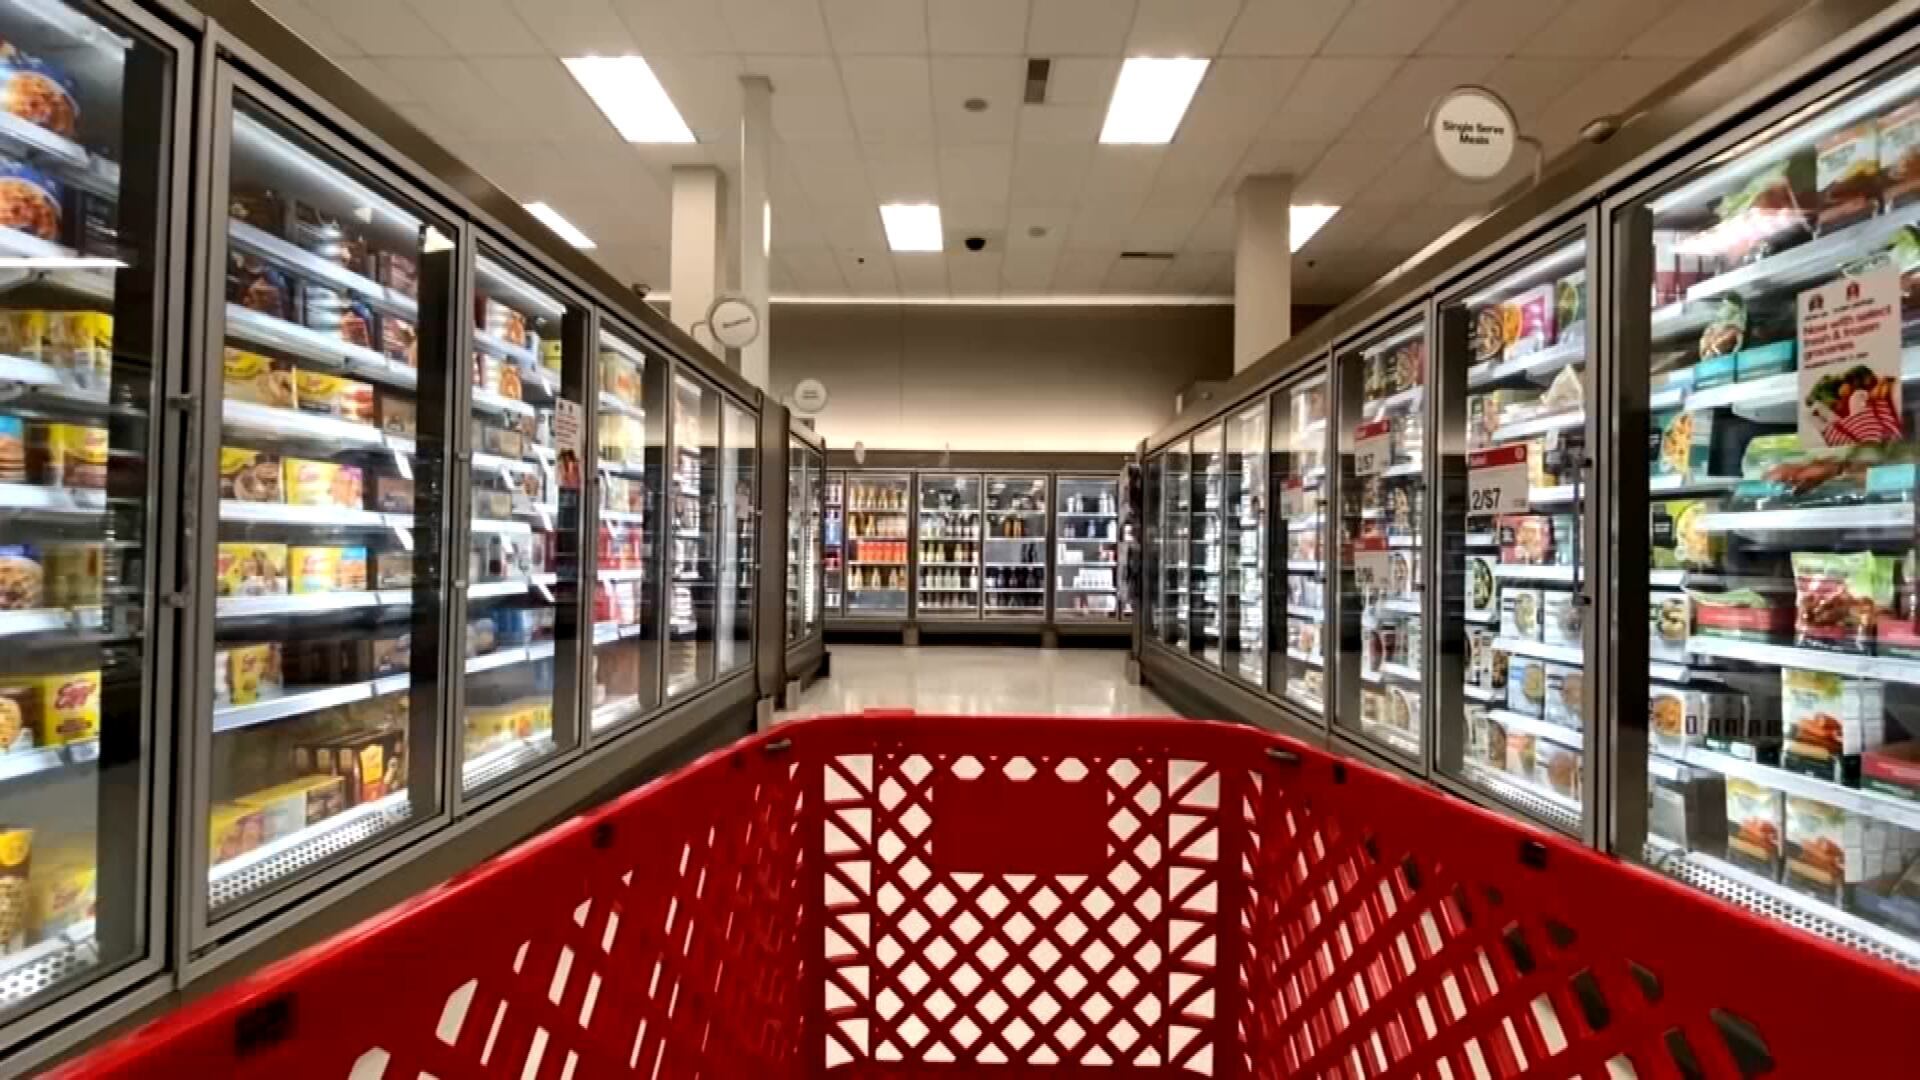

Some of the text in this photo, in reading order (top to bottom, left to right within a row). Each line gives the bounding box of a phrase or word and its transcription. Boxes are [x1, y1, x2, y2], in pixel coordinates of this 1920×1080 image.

[1442, 120, 1505, 135] Single Serve
[1459, 133, 1490, 145] Meals
